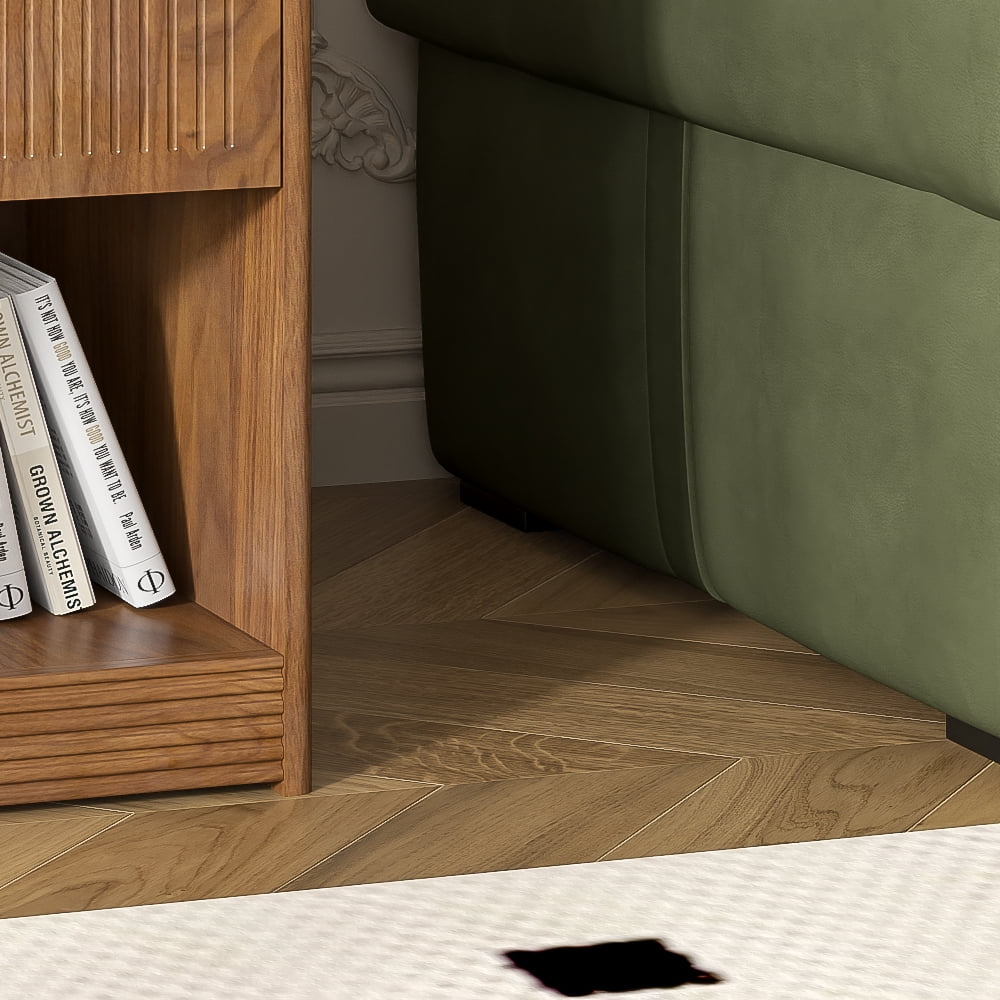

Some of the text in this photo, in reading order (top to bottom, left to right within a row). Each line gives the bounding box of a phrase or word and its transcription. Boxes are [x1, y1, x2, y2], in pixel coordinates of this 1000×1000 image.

[34, 293, 128, 505] IT'S NOT HOW GOOD YOU ARE, IT'S HOW GOOD YOU WANT TO BE.
[29, 464, 83, 611] GROWN ALCHEMIS
[33, 516, 54, 576] BOTANICAL BEAUTY
[119, 511, 143, 551] Paul Arden
